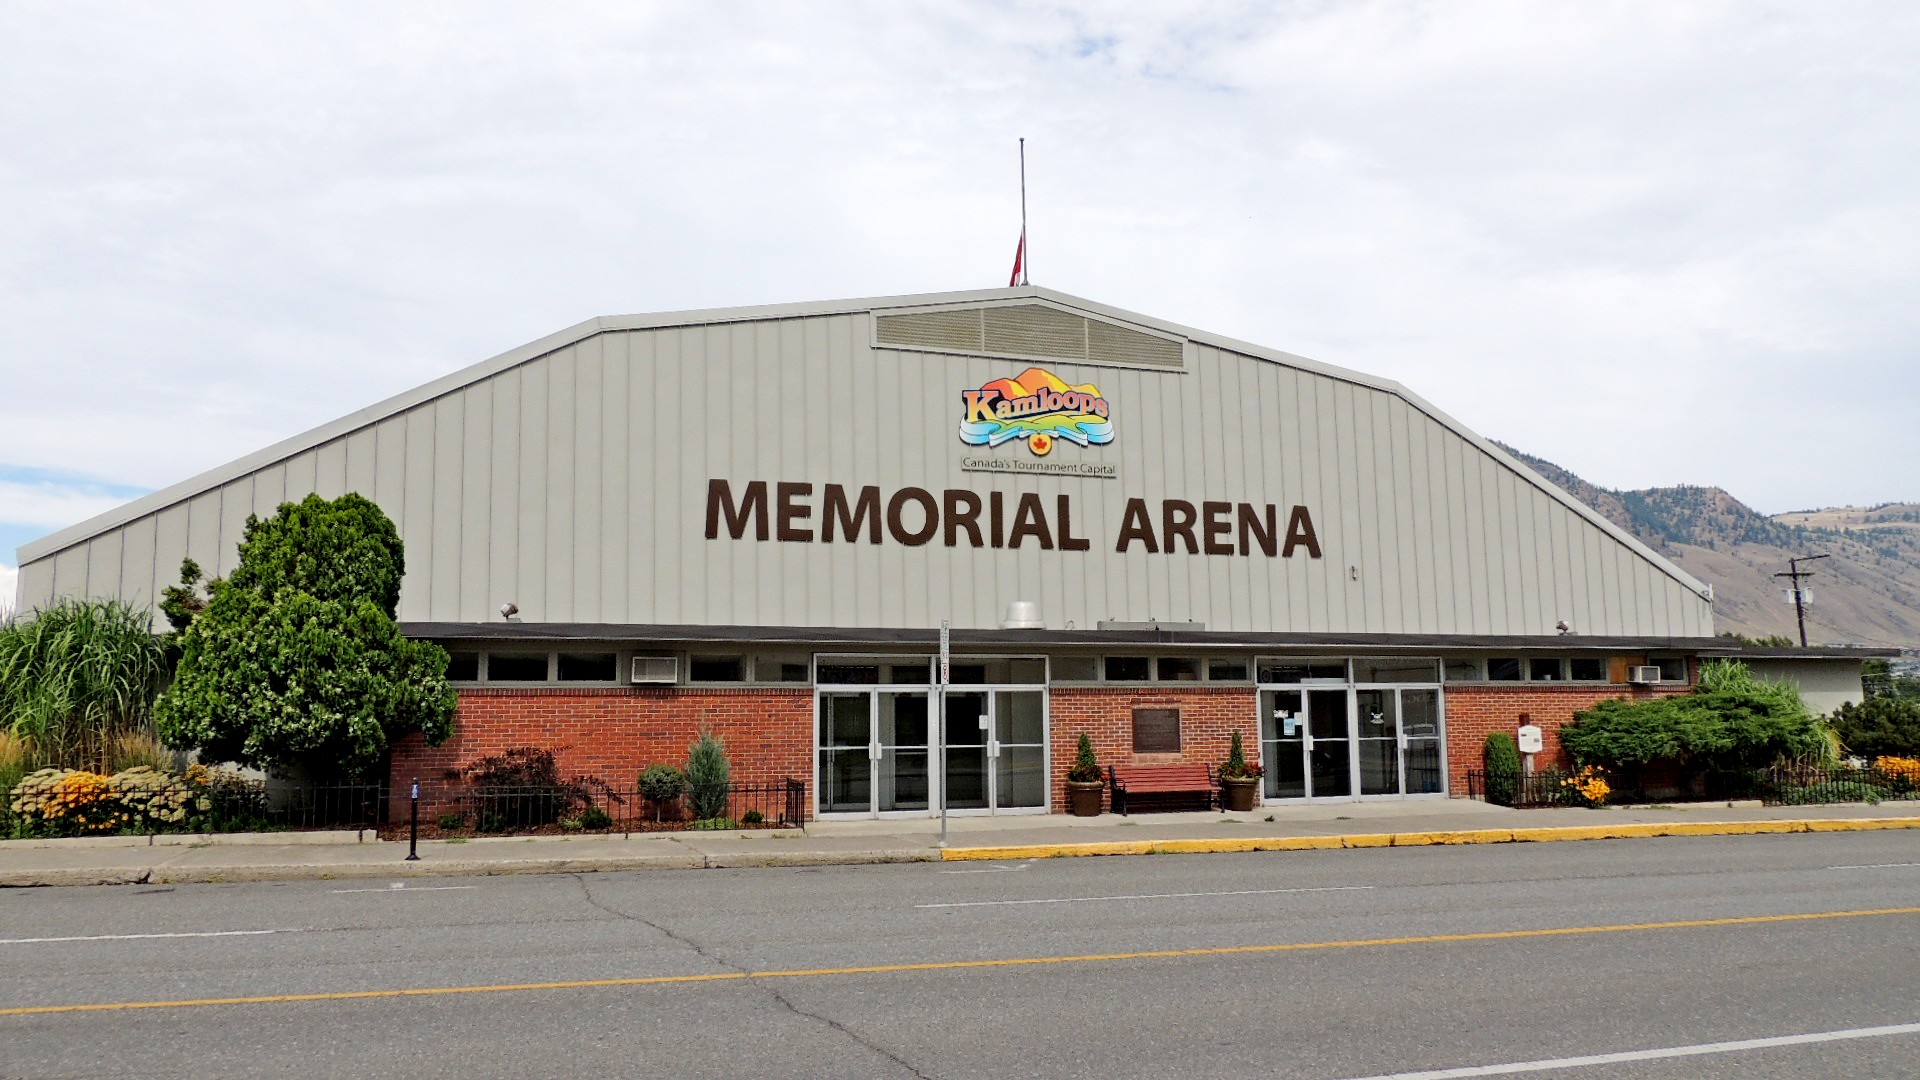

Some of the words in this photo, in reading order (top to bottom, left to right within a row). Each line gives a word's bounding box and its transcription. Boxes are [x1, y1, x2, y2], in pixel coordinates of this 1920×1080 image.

[962, 387, 1109, 421] Kamloops
[962, 457, 1011, 469] Canada's
[1013, 460, 1077, 473] Tournament
[1080, 463, 1116, 476] Capital
[705, 479, 1090, 550] MEMORIAL
[1116, 498, 1322, 558] ARENA
